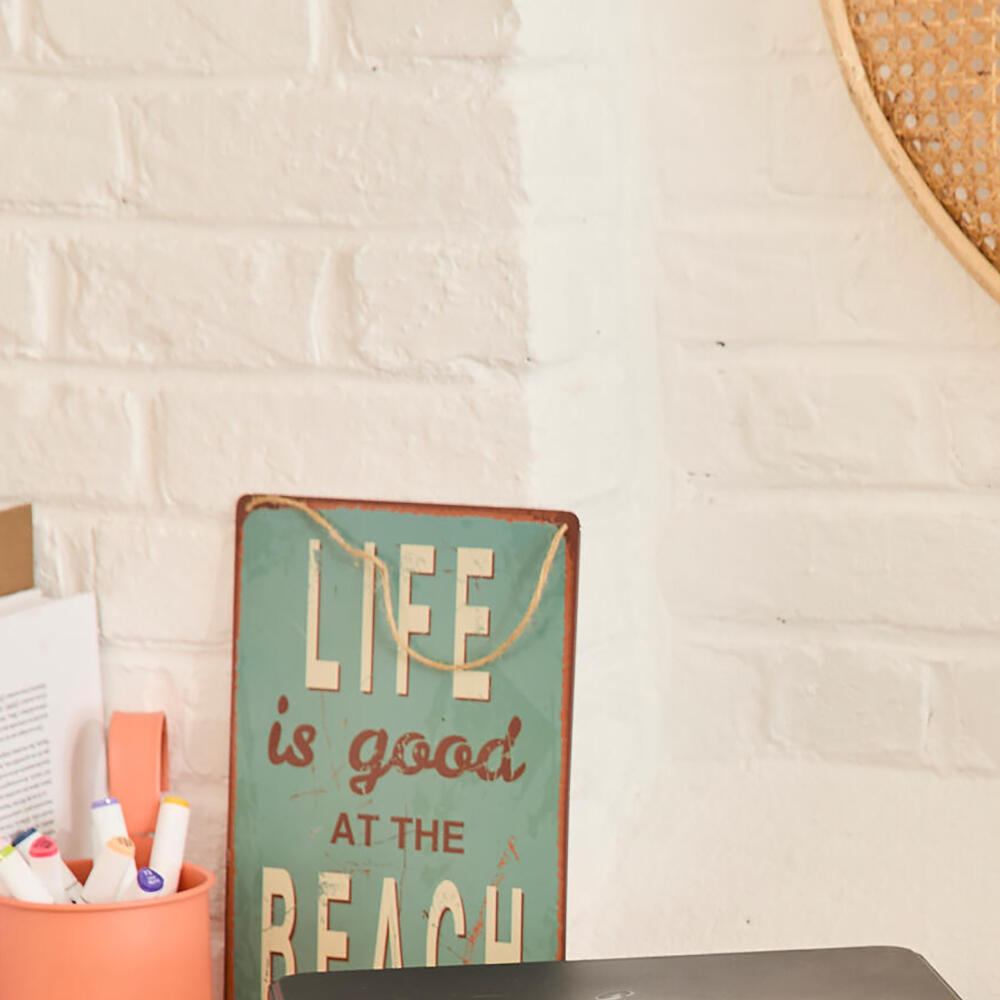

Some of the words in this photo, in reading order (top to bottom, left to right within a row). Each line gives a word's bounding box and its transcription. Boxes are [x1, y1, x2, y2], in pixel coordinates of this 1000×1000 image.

[305, 539, 496, 702] LIFE
[267, 695, 318, 768] is
[348, 715, 528, 796] good
[331, 813, 380, 847] AT
[390, 816, 465, 854] THE
